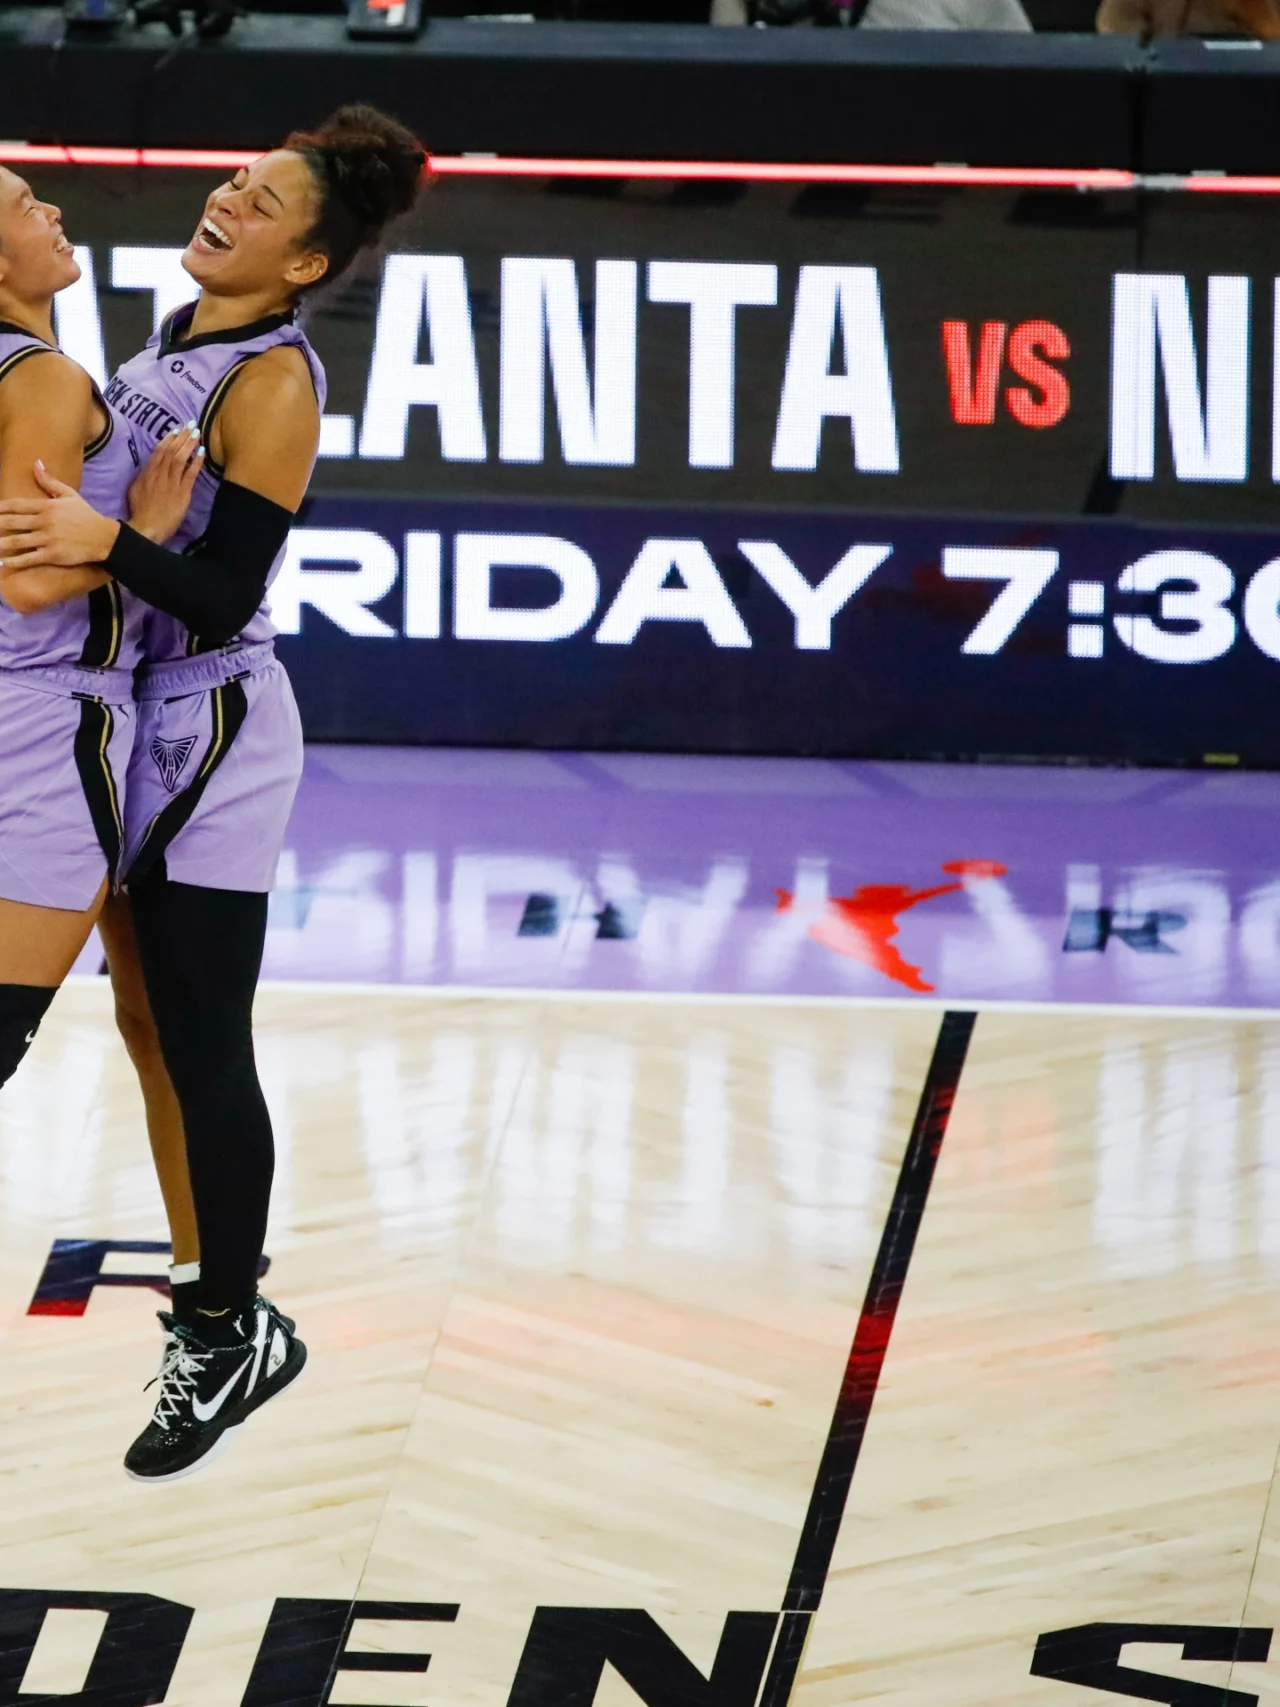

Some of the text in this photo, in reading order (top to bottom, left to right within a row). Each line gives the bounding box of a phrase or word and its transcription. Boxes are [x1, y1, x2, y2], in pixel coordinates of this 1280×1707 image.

[180, 370, 206, 394] freedom
[941, 320, 1070, 428] VS
[1111, 273, 1280, 483] N
[273, 529, 1280, 664] RIDAY 7:3
